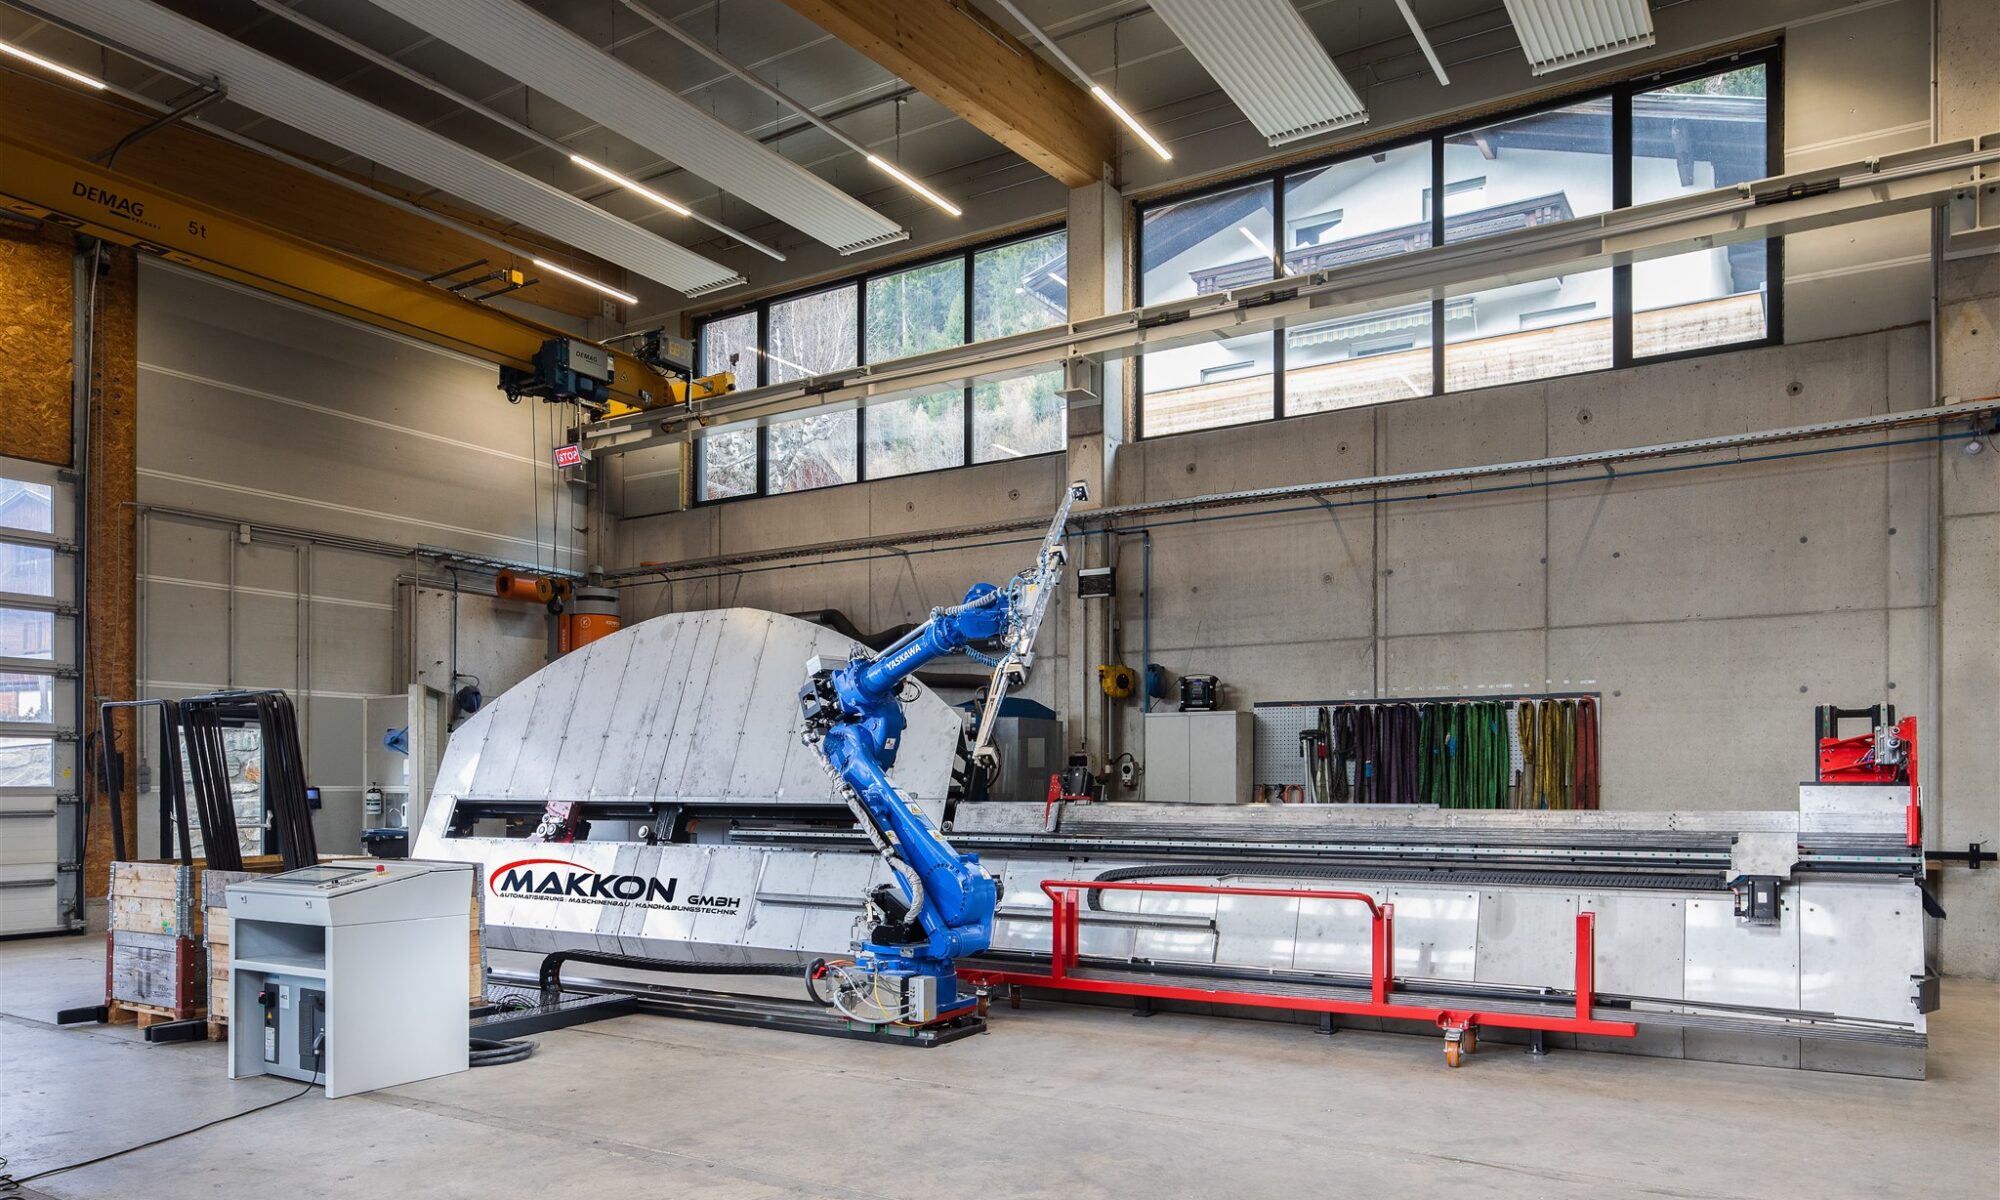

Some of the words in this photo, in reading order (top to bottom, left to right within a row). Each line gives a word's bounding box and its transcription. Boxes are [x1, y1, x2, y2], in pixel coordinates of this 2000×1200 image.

[72, 181, 144, 217] DEMAG
[575, 351, 598, 362] DEMAG
[558, 450, 577, 462] STOP
[886, 643, 921, 670] YASKAWA
[500, 868, 678, 903] MAKKON
[500, 892, 564, 902] AUTOMATISIERUNG
[568, 897, 631, 907] MASCHINENBAU
[635, 902, 738, 915] HANDHABUNGSTECHNIK
